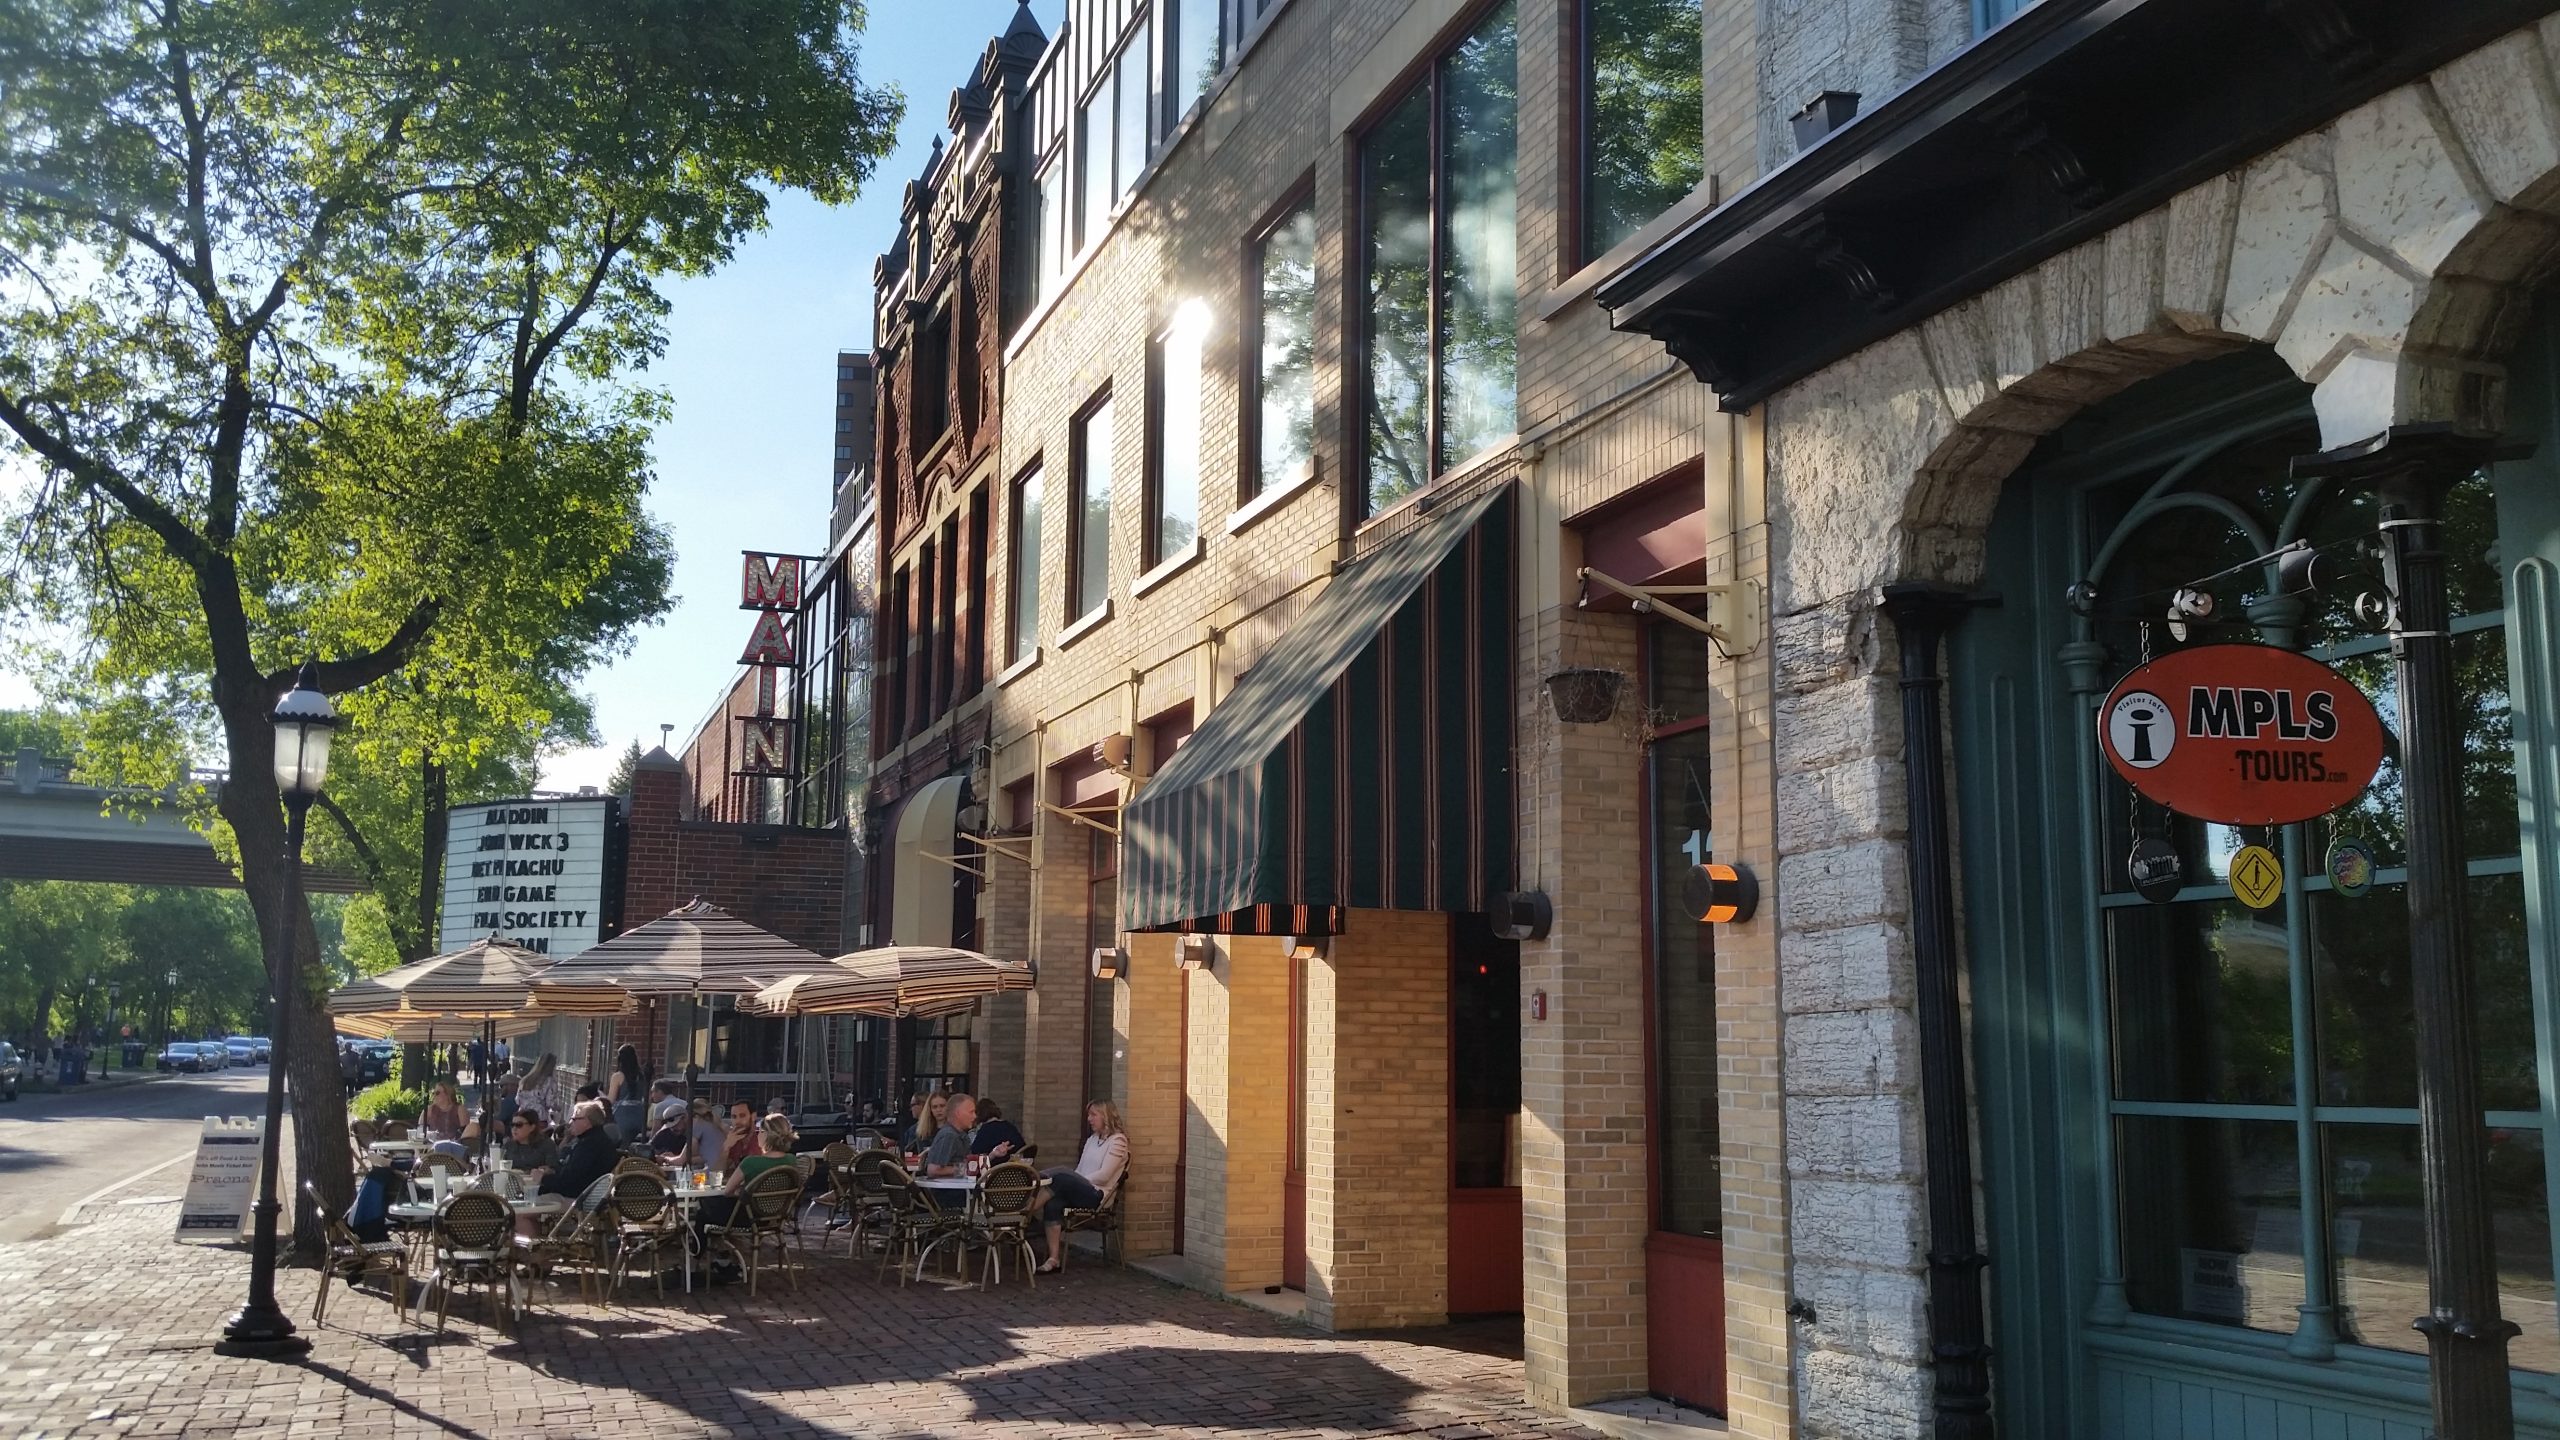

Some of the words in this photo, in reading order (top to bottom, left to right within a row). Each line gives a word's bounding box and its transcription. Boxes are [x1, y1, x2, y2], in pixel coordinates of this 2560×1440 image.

[743, 555, 799, 772] MAIN
[2118, 697, 2146, 712] Visitor
[2187, 685, 2338, 742] MPLS
[485, 808, 548, 825] ALADDIN
[509, 834, 552, 850] WICK
[557, 832, 569, 852] 3
[1682, 830, 1712, 866] 1
[503, 910, 587, 929] SOCIETY
